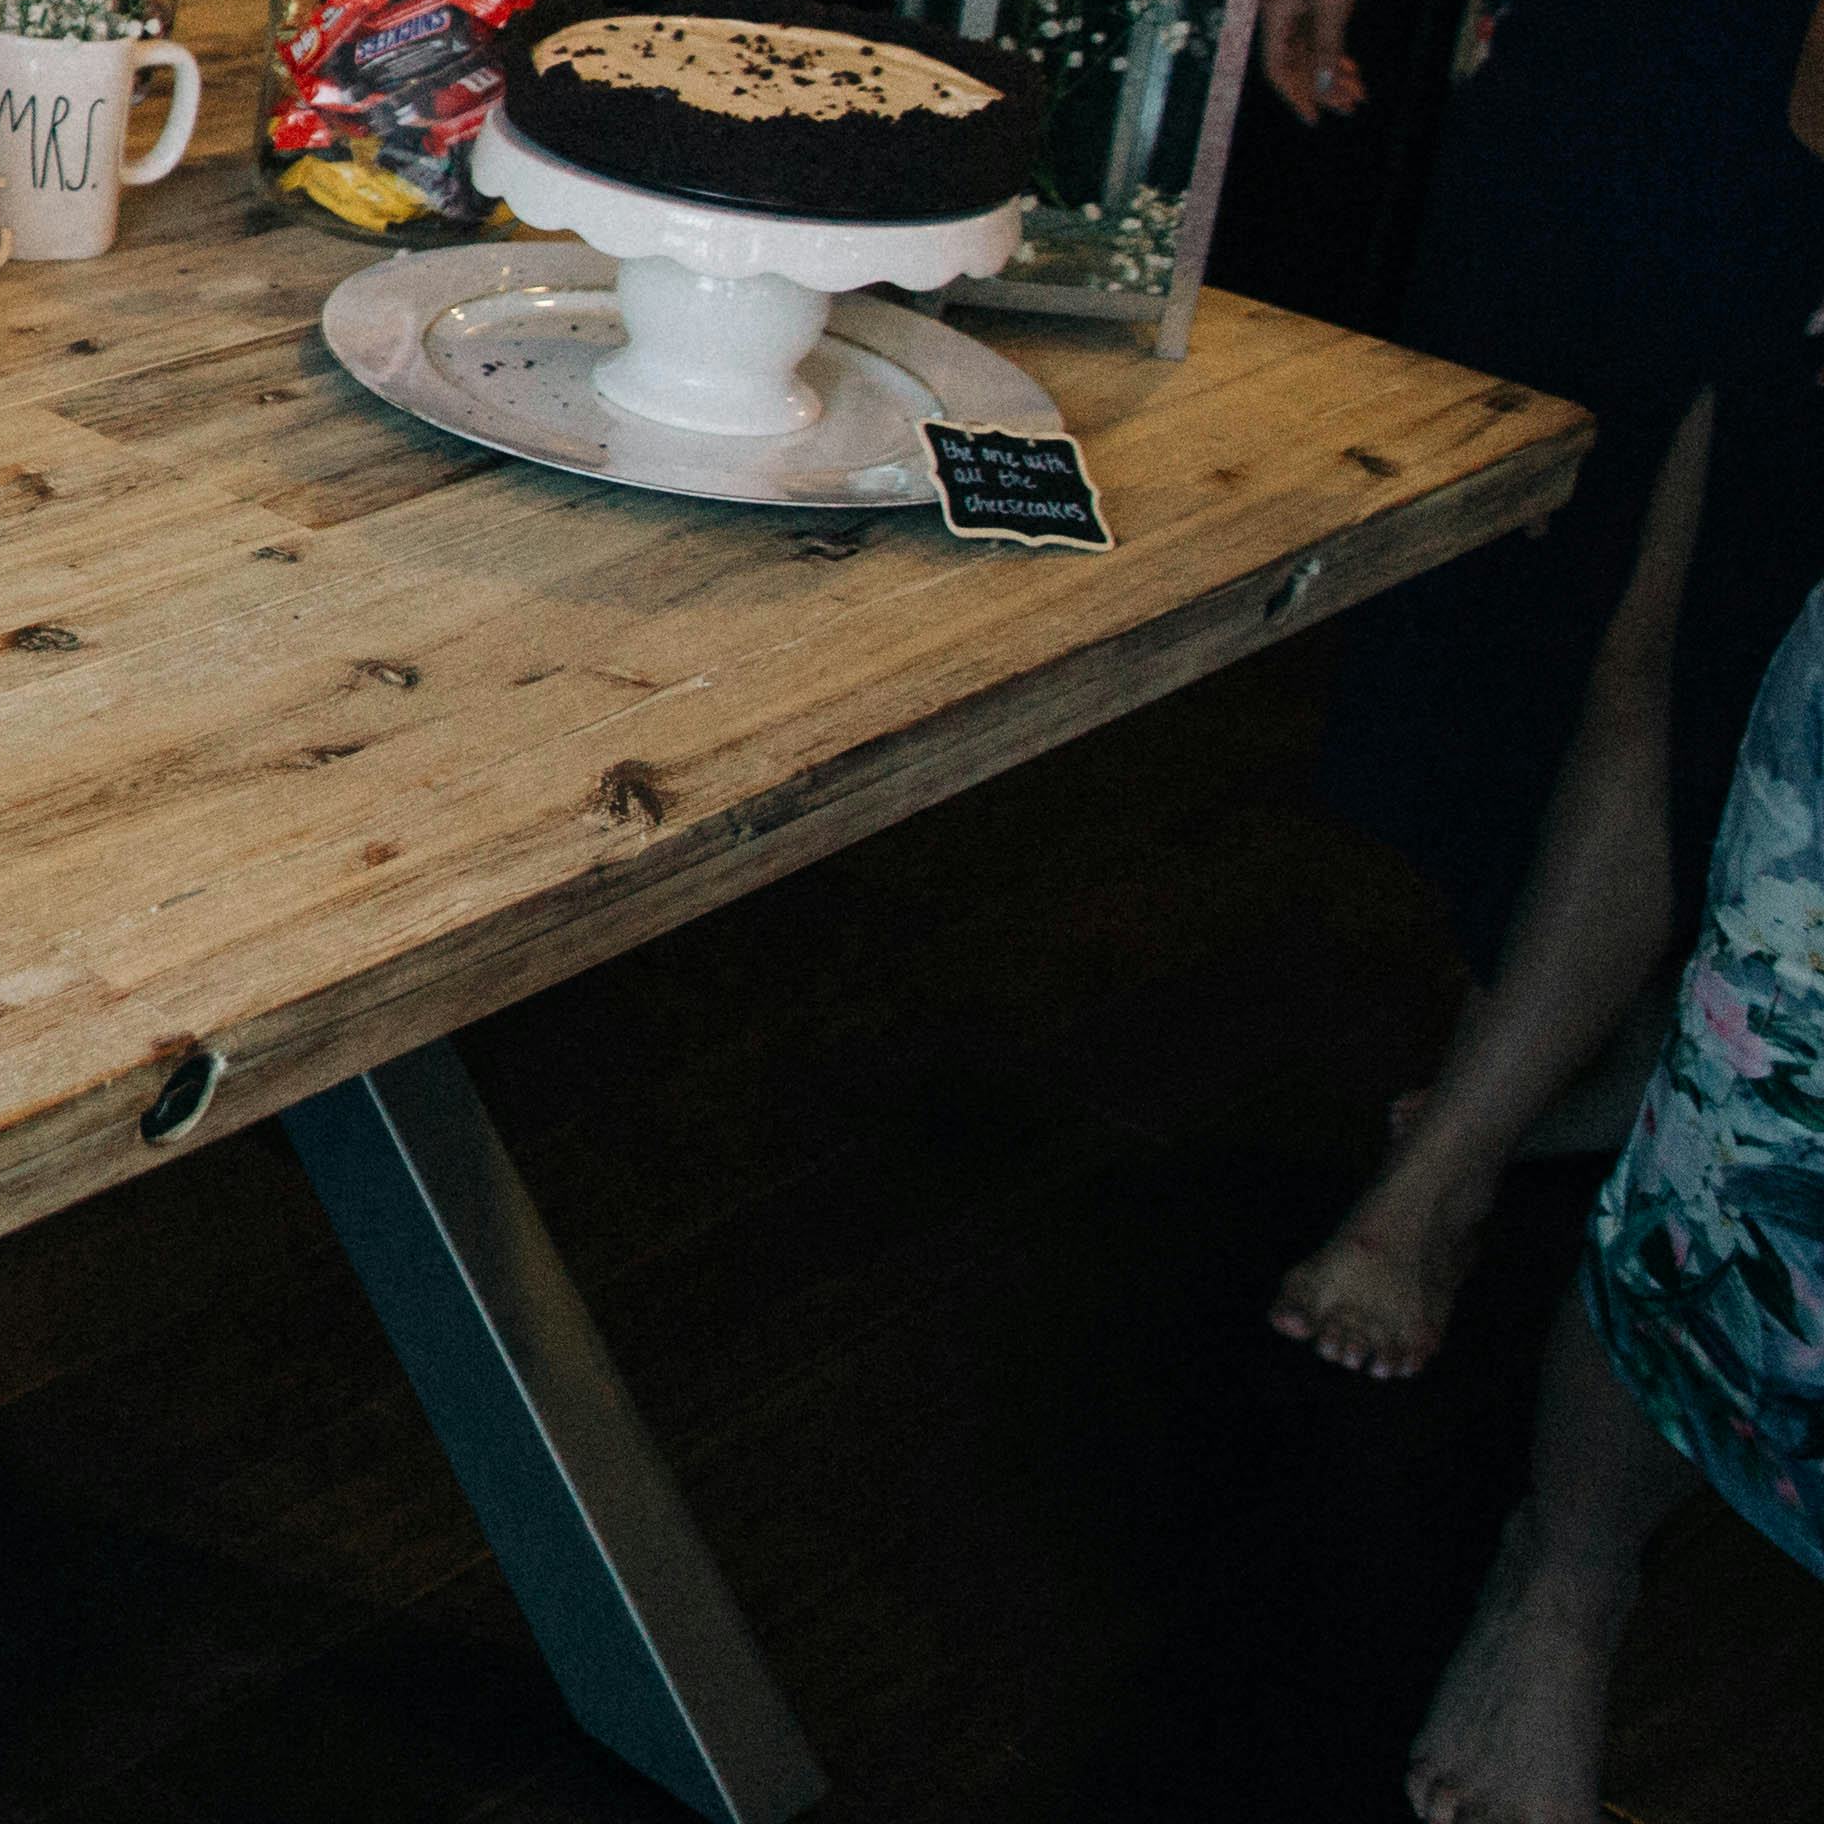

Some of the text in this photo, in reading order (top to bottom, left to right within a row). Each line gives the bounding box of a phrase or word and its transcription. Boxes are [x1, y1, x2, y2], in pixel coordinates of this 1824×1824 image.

[941, 438, 1074, 475] the one with
[954, 467, 1038, 490] all the
